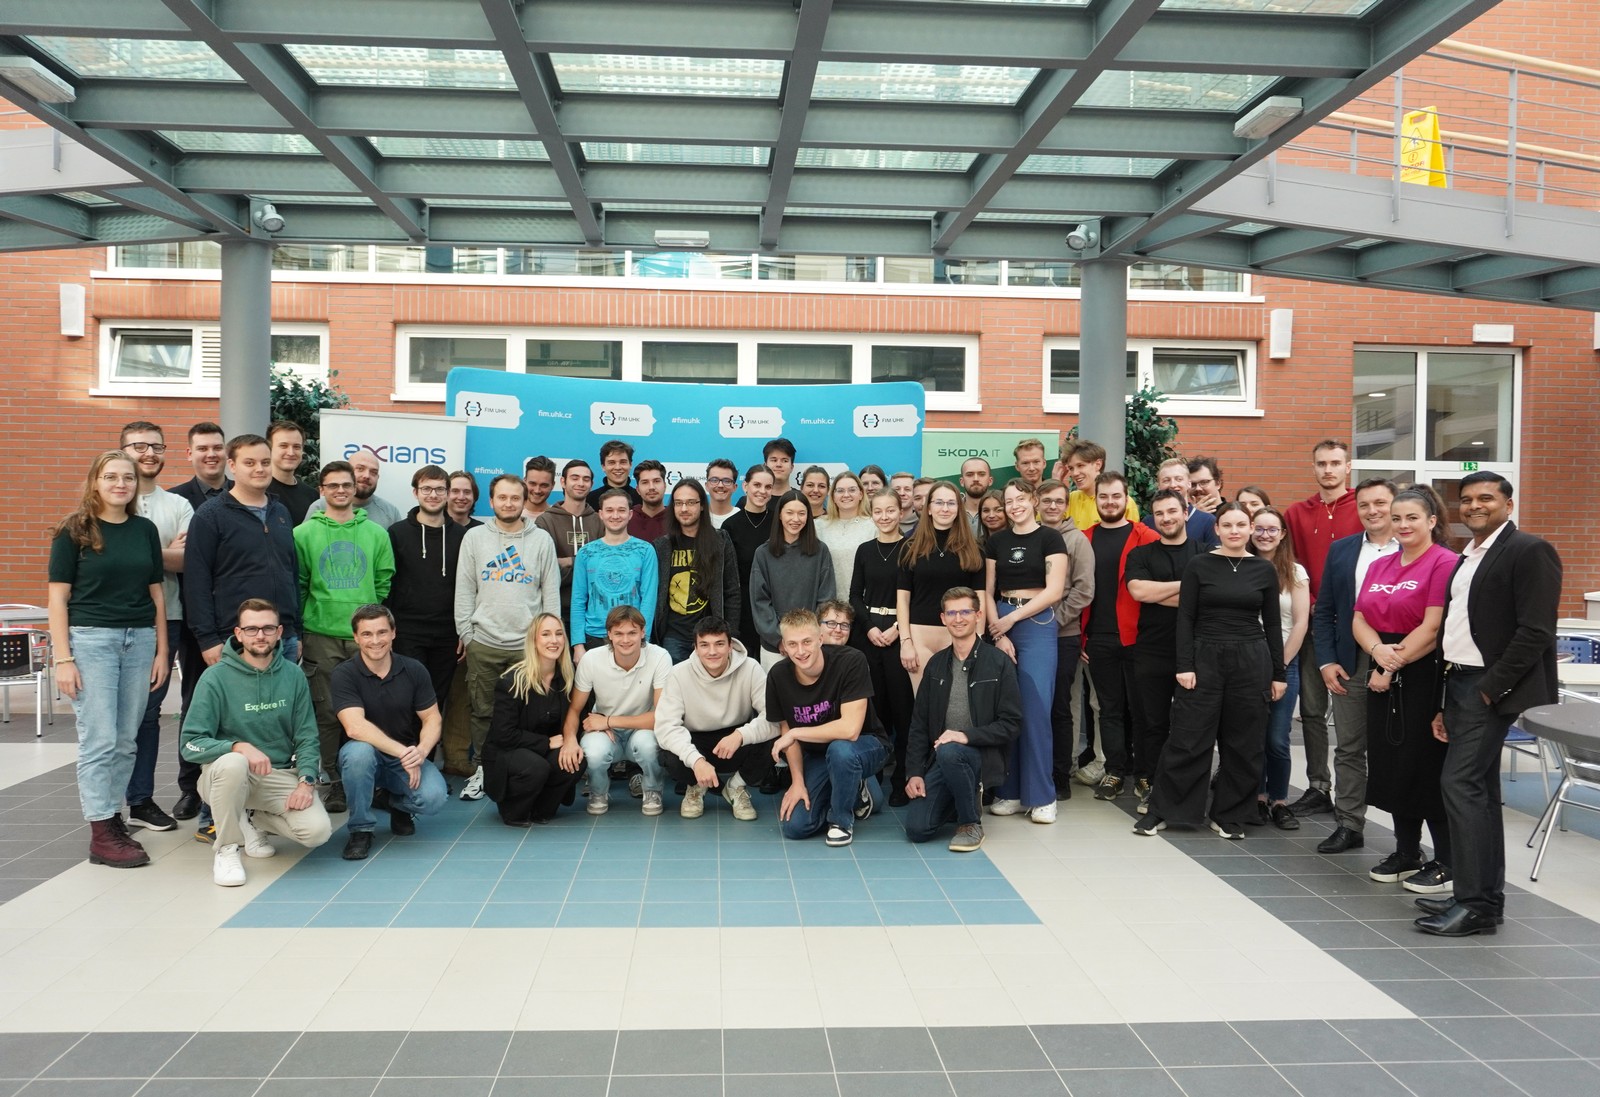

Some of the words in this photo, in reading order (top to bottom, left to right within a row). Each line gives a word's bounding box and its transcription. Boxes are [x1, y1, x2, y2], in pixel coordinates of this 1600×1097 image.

[538, 409, 573, 419] fim.uhk.cz
[800, 417, 835, 425] fim.uhk.cz
[343, 443, 446, 465] axians
[991, 449, 1001, 457] IT
[474, 467, 504, 475] #fimuhk
[481, 569, 533, 584] adidas
[244, 702, 278, 712] Explore
[794, 706, 812, 716] FLIP
[794, 713, 818, 723] CAN'T
